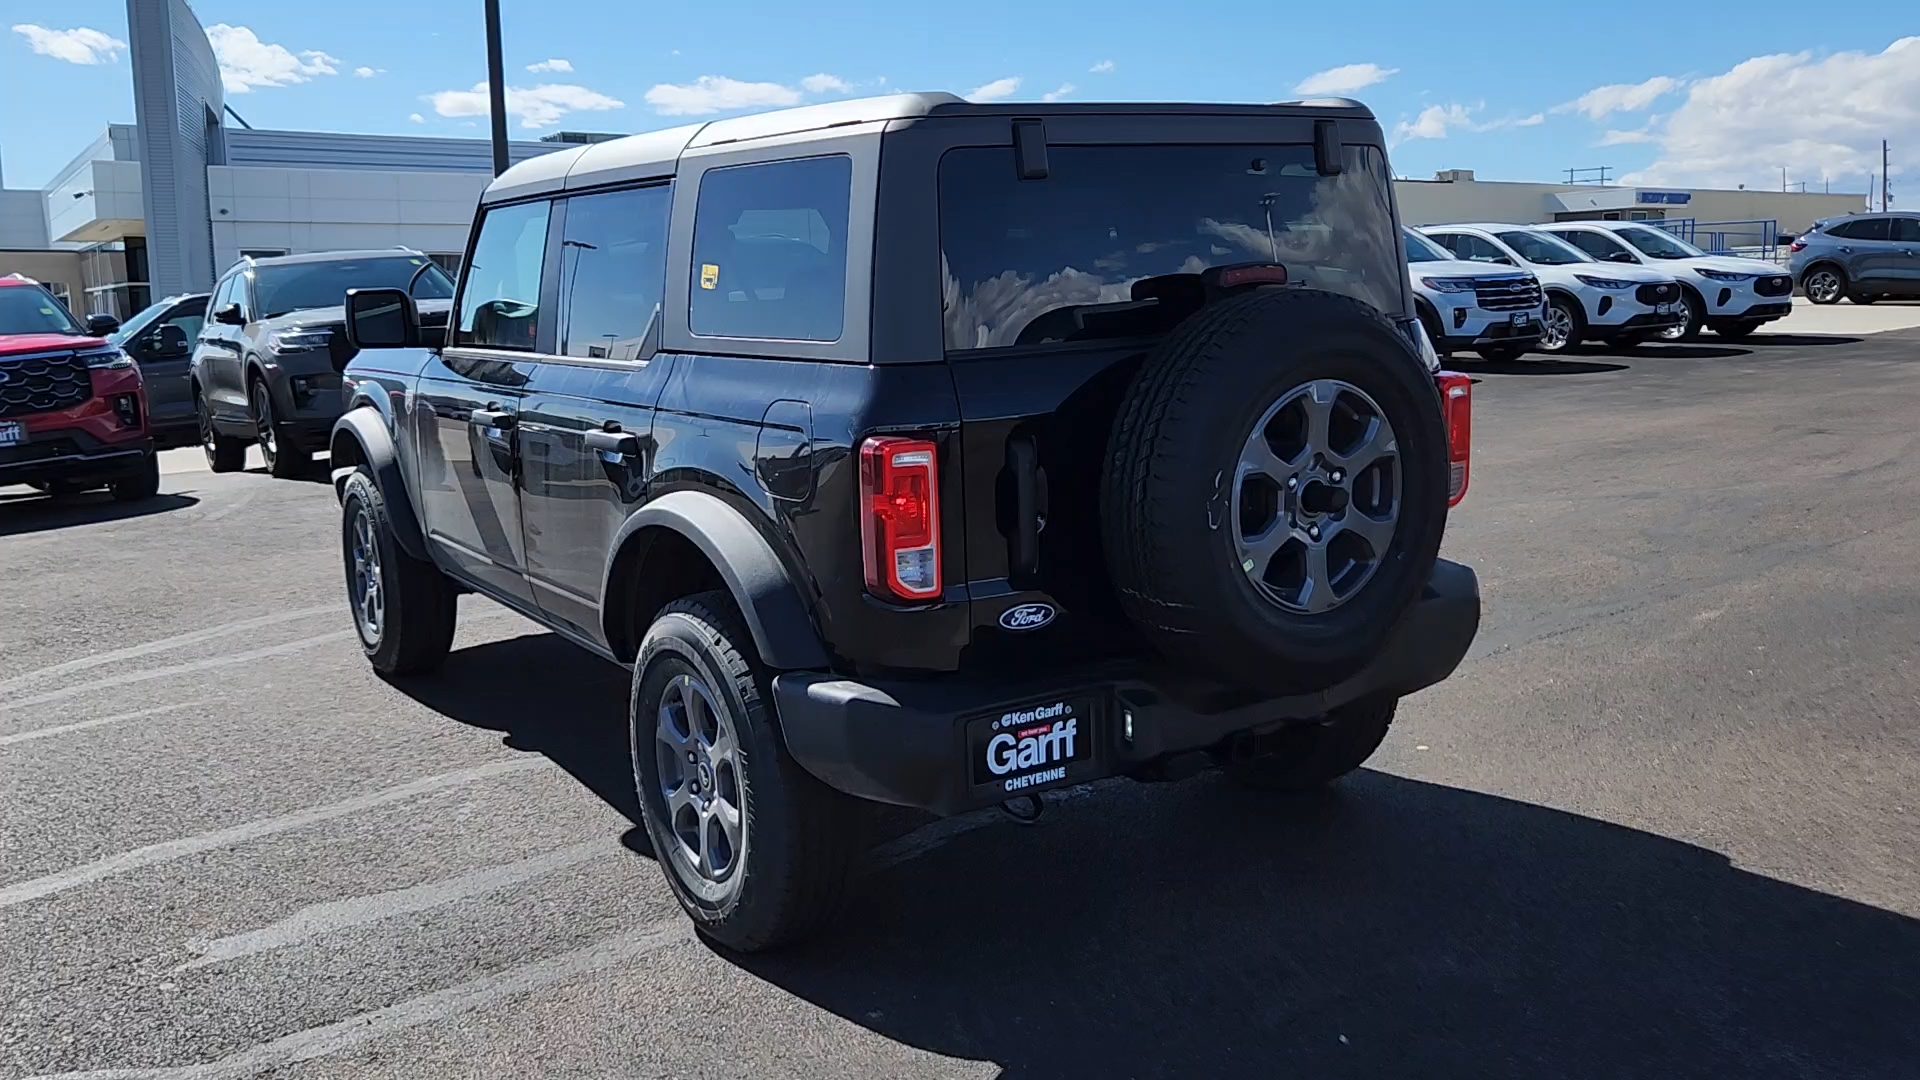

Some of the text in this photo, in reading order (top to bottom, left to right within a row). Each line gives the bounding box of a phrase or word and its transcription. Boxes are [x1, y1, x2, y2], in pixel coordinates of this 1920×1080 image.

[1011, 607, 1045, 626] Ford
[986, 718, 1077, 775] Garff
[1004, 766, 1066, 792] CHEYENNE
